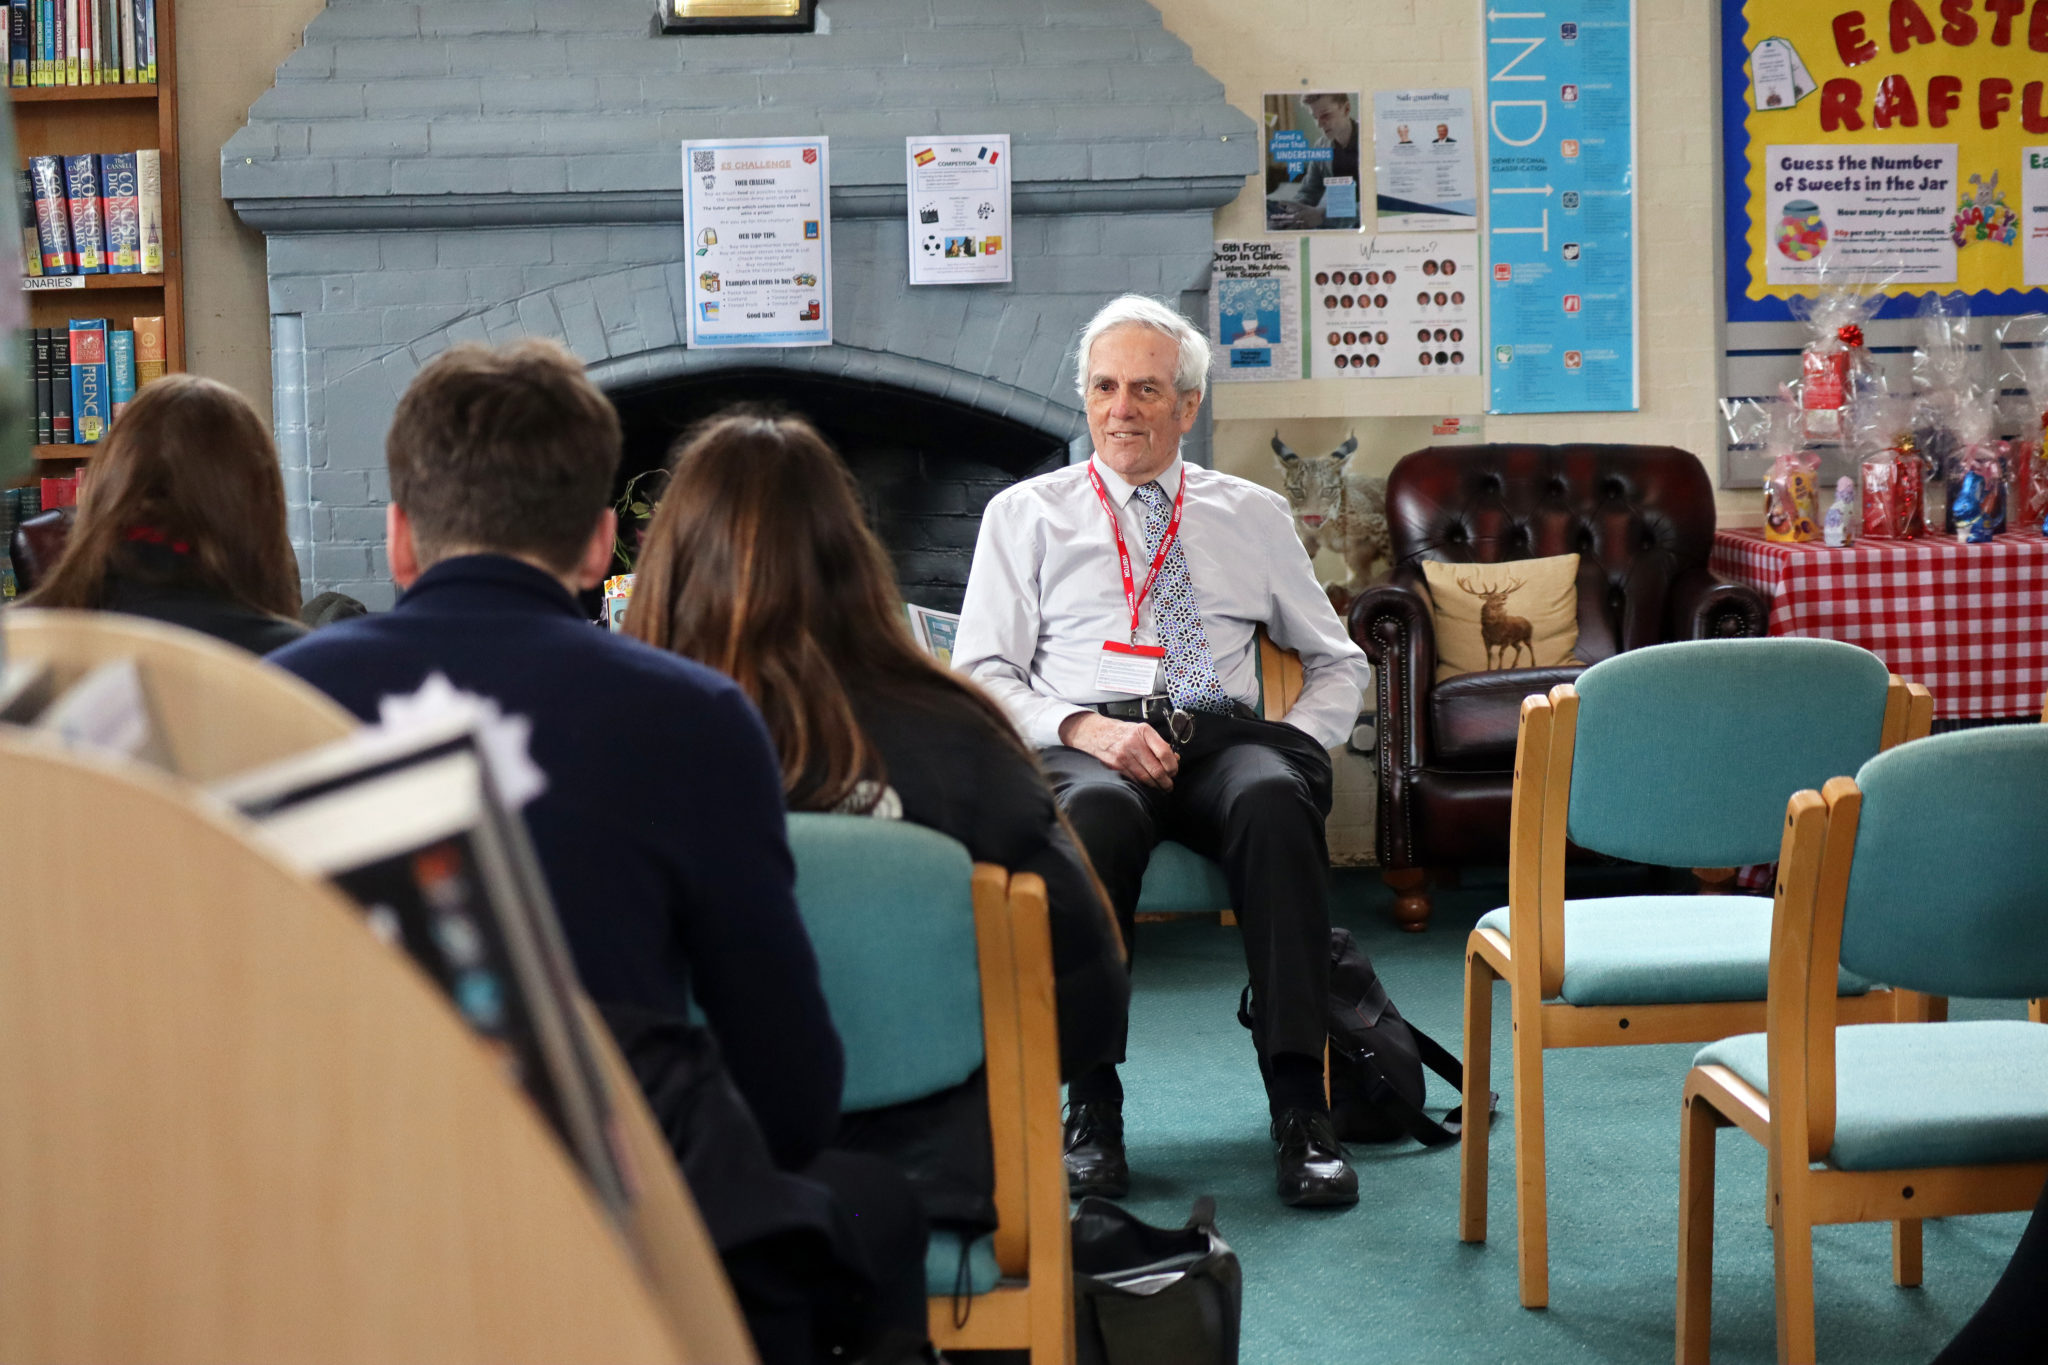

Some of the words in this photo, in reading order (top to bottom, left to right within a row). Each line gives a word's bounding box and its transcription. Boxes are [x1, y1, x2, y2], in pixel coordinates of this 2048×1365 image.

[14, 3, 27, 36] Latin
[1396, 93, 1450, 101] Safeguarding
[1820, 74, 2048, 134] RAFFL
[1276, 150, 1331, 159] UNDERSTANDS
[735, 159, 792, 170] CHALLENGE
[1289, 162, 1302, 172] ME
[1780, 156, 1834, 171] Guess
[1838, 155, 1867, 170] the
[1871, 155, 1943, 170] Number
[748, 178, 775, 186] CHALLENGE
[1774, 176, 1794, 191] of
[1797, 176, 1861, 191] Sweets
[1865, 175, 1881, 191] in
[1886, 176, 1914, 191] the
[1918, 176, 1948, 191] Jar
[69, 174, 86, 248] DICTIONARY
[80, 173, 101, 246] CONCISE
[107, 173, 124, 246] DICTIONARY
[118, 171, 137, 246] CONCISE
[1837, 208, 1857, 216] How
[1859, 209, 1884, 218] many
[1885, 207, 1896, 216] do
[1898, 208, 1915, 218] you
[1917, 206, 1946, 216] think?
[1864, 229, 1886, 237] entry
[1222, 243, 1240, 252] 6th
[1242, 242, 1271, 252] Form
[1240, 252, 1250, 260] In
[1252, 251, 1283, 260] Clinic
[1261, 263, 1291, 272] Advise,
[1240, 271, 1270, 279] Support
[23, 277, 73, 289] ONARIES
[725, 279, 751, 287] Examples
[758, 278, 773, 286] items
[82, 366, 98, 417] FRENC
[1160, 534, 1173, 556] VISITOR
[1122, 554, 1131, 579] VISITOR
[1144, 568, 1157, 591] VISITOR
